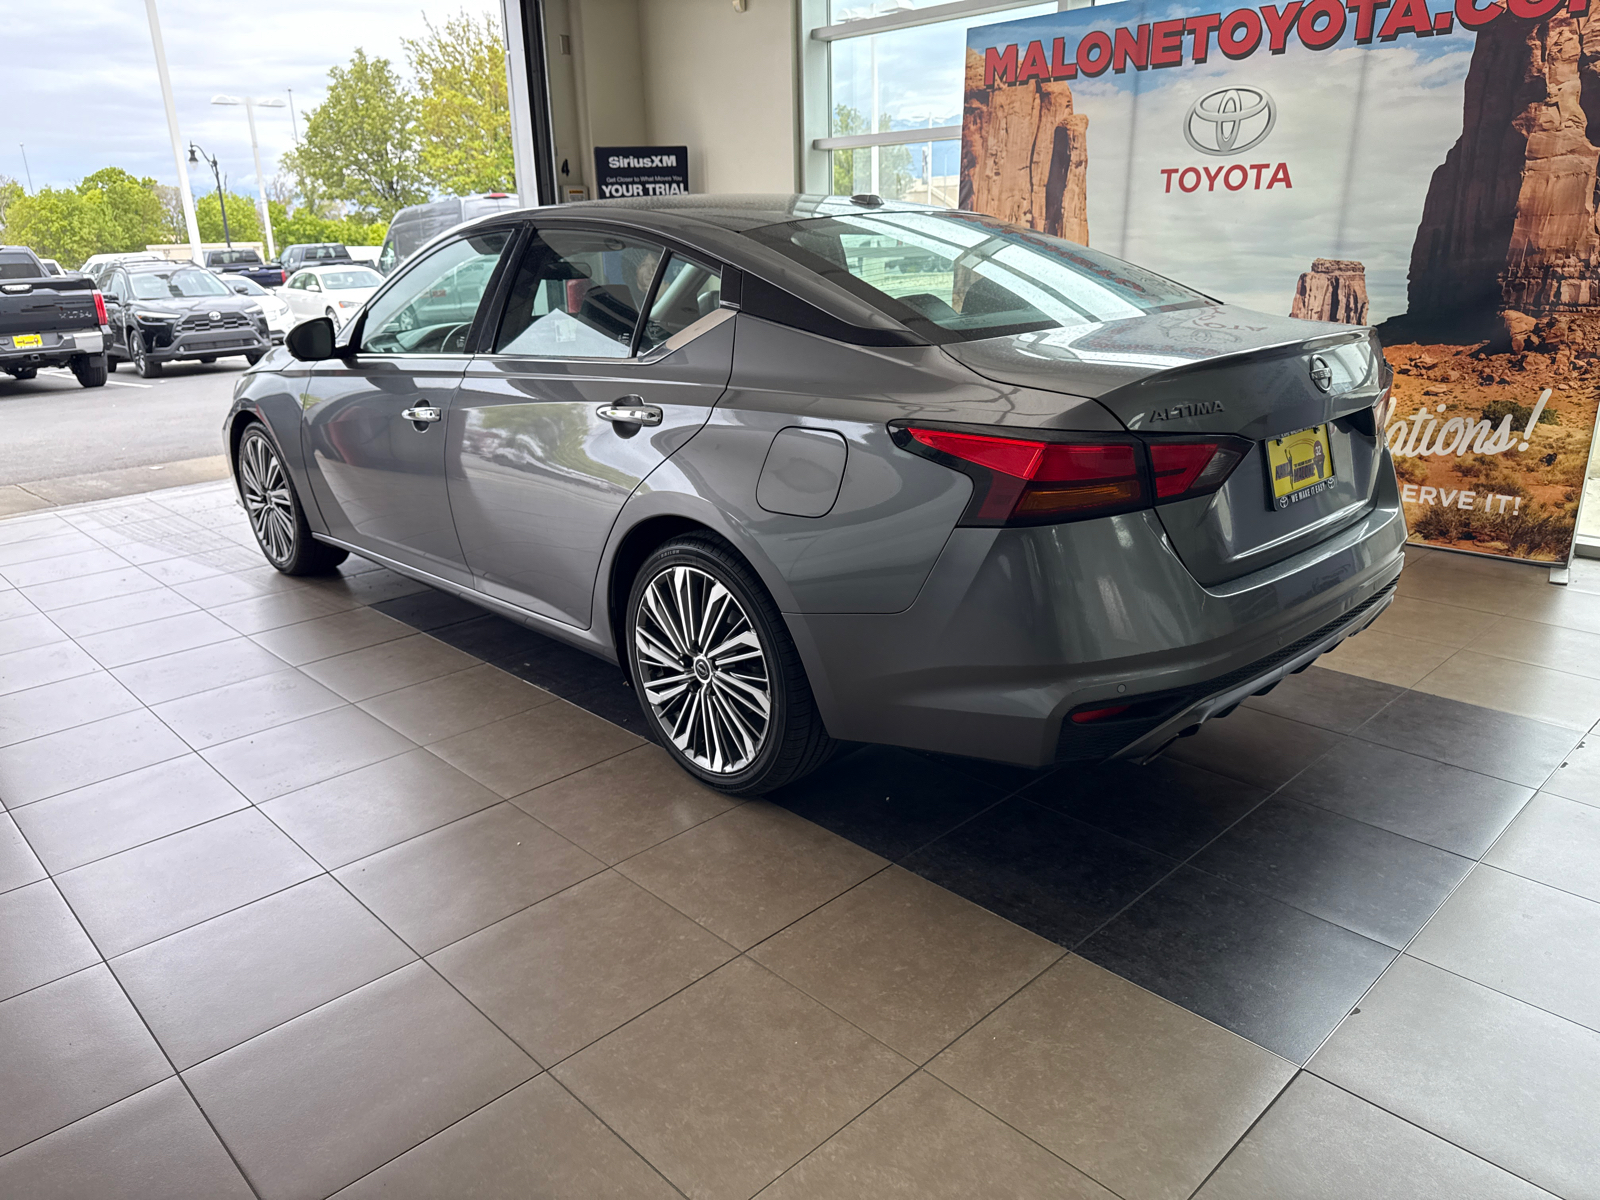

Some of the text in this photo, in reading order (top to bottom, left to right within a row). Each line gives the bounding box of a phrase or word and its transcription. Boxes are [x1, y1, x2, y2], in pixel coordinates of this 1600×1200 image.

[984, 0, 1591, 88] MALONETOYOTA.C
[561, 159, 570, 177] 4
[608, 155, 677, 169] SiriusXM
[1160, 162, 1293, 194] TOYOTA
[601, 183, 689, 197] YOUR TRIAL
[1149, 400, 1226, 423] ALTIMA
[1485, 493, 1522, 516] IT!
